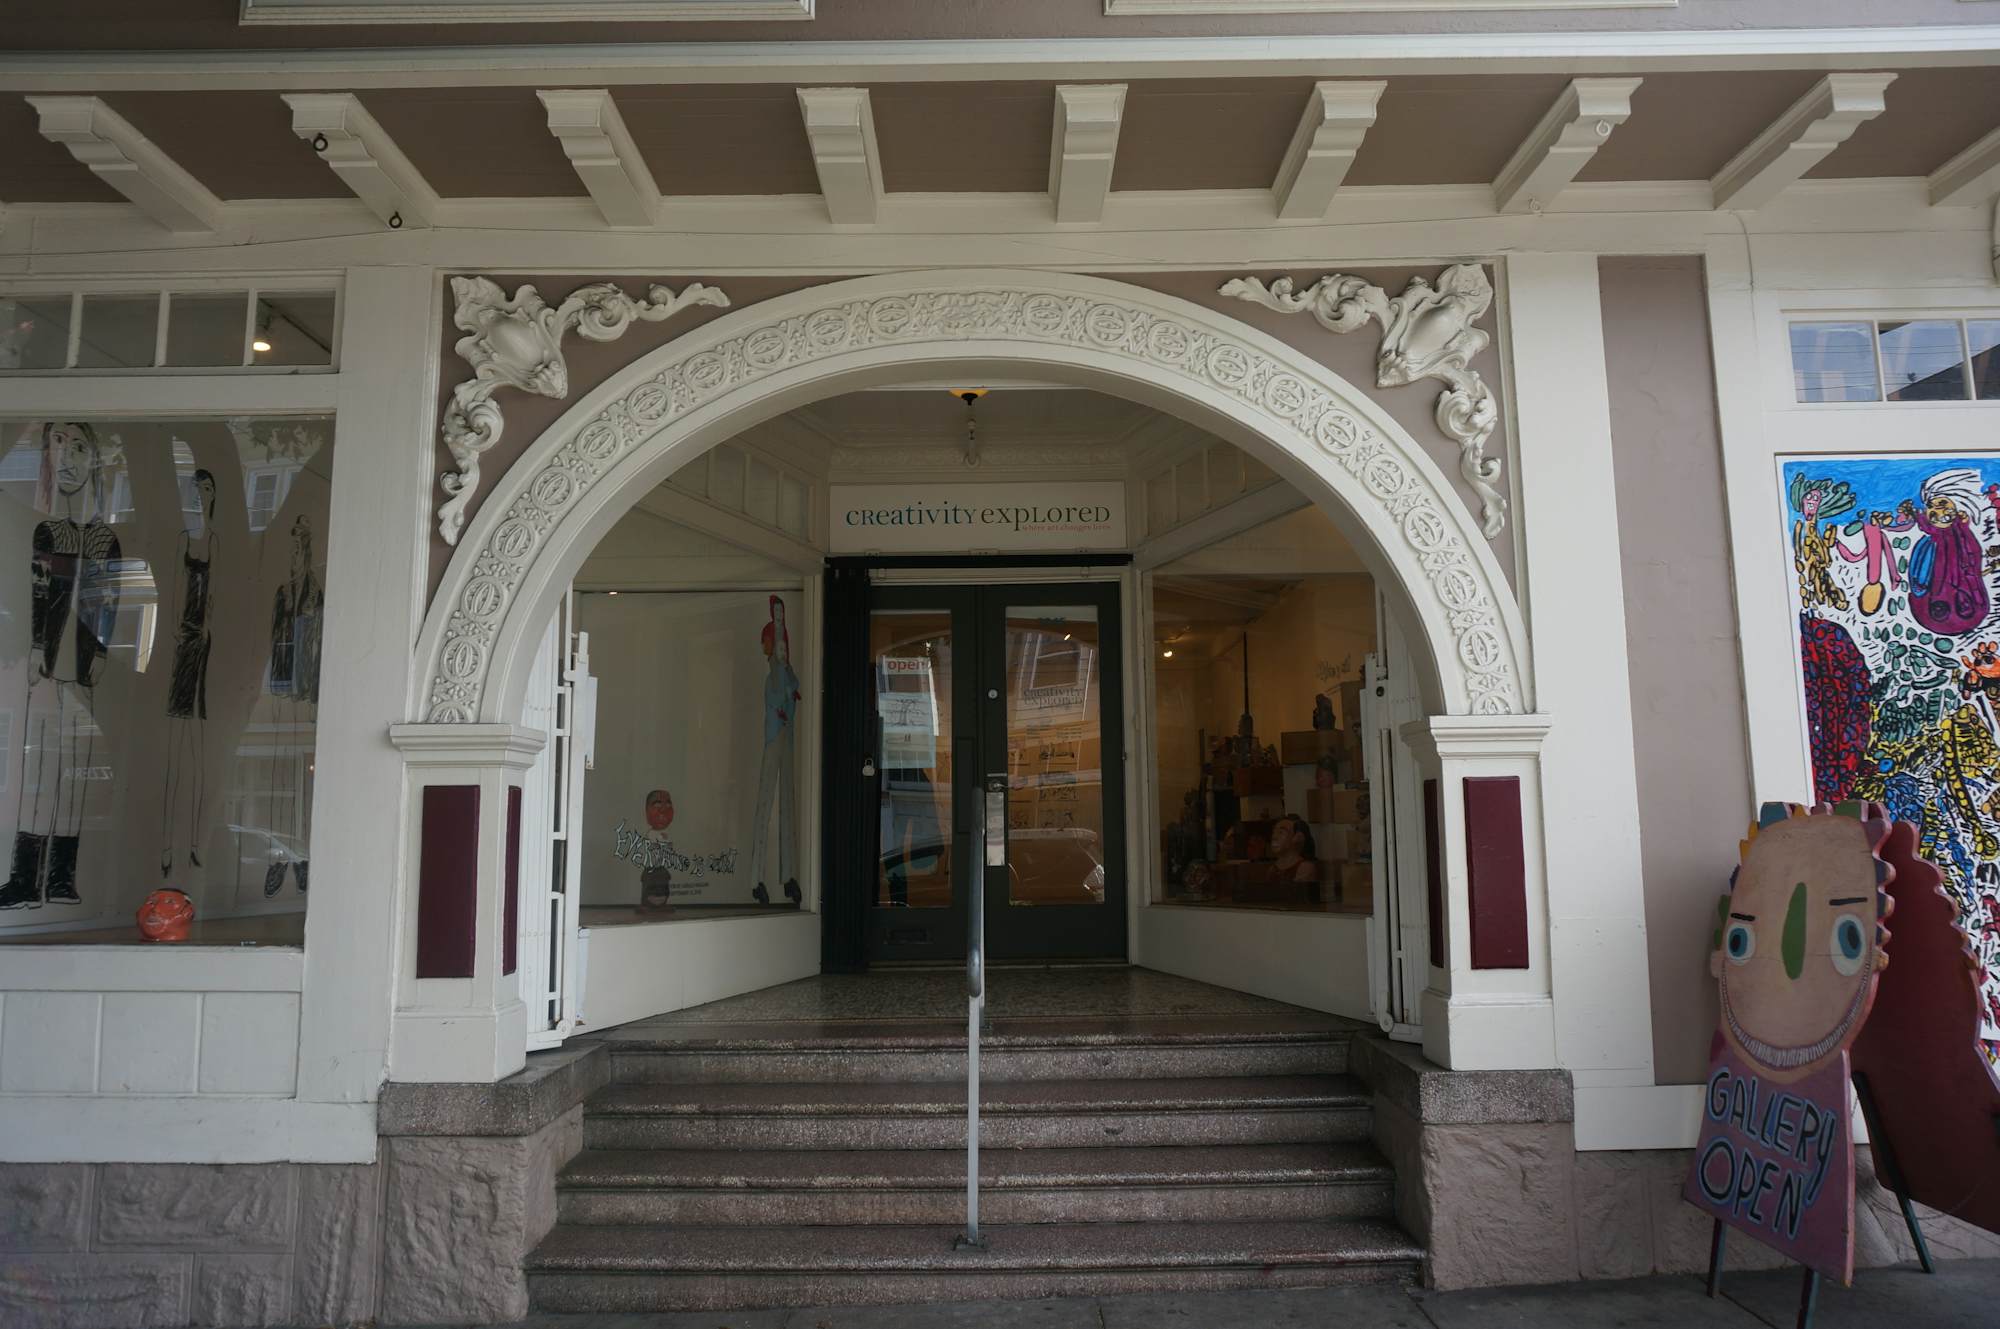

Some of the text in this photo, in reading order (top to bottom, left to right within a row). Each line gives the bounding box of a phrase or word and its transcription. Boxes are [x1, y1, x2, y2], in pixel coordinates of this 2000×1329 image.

[887, 660, 926, 673] open
[1709, 1069, 1837, 1205] GALLERY
[1700, 1139, 1803, 1238] OPEN
